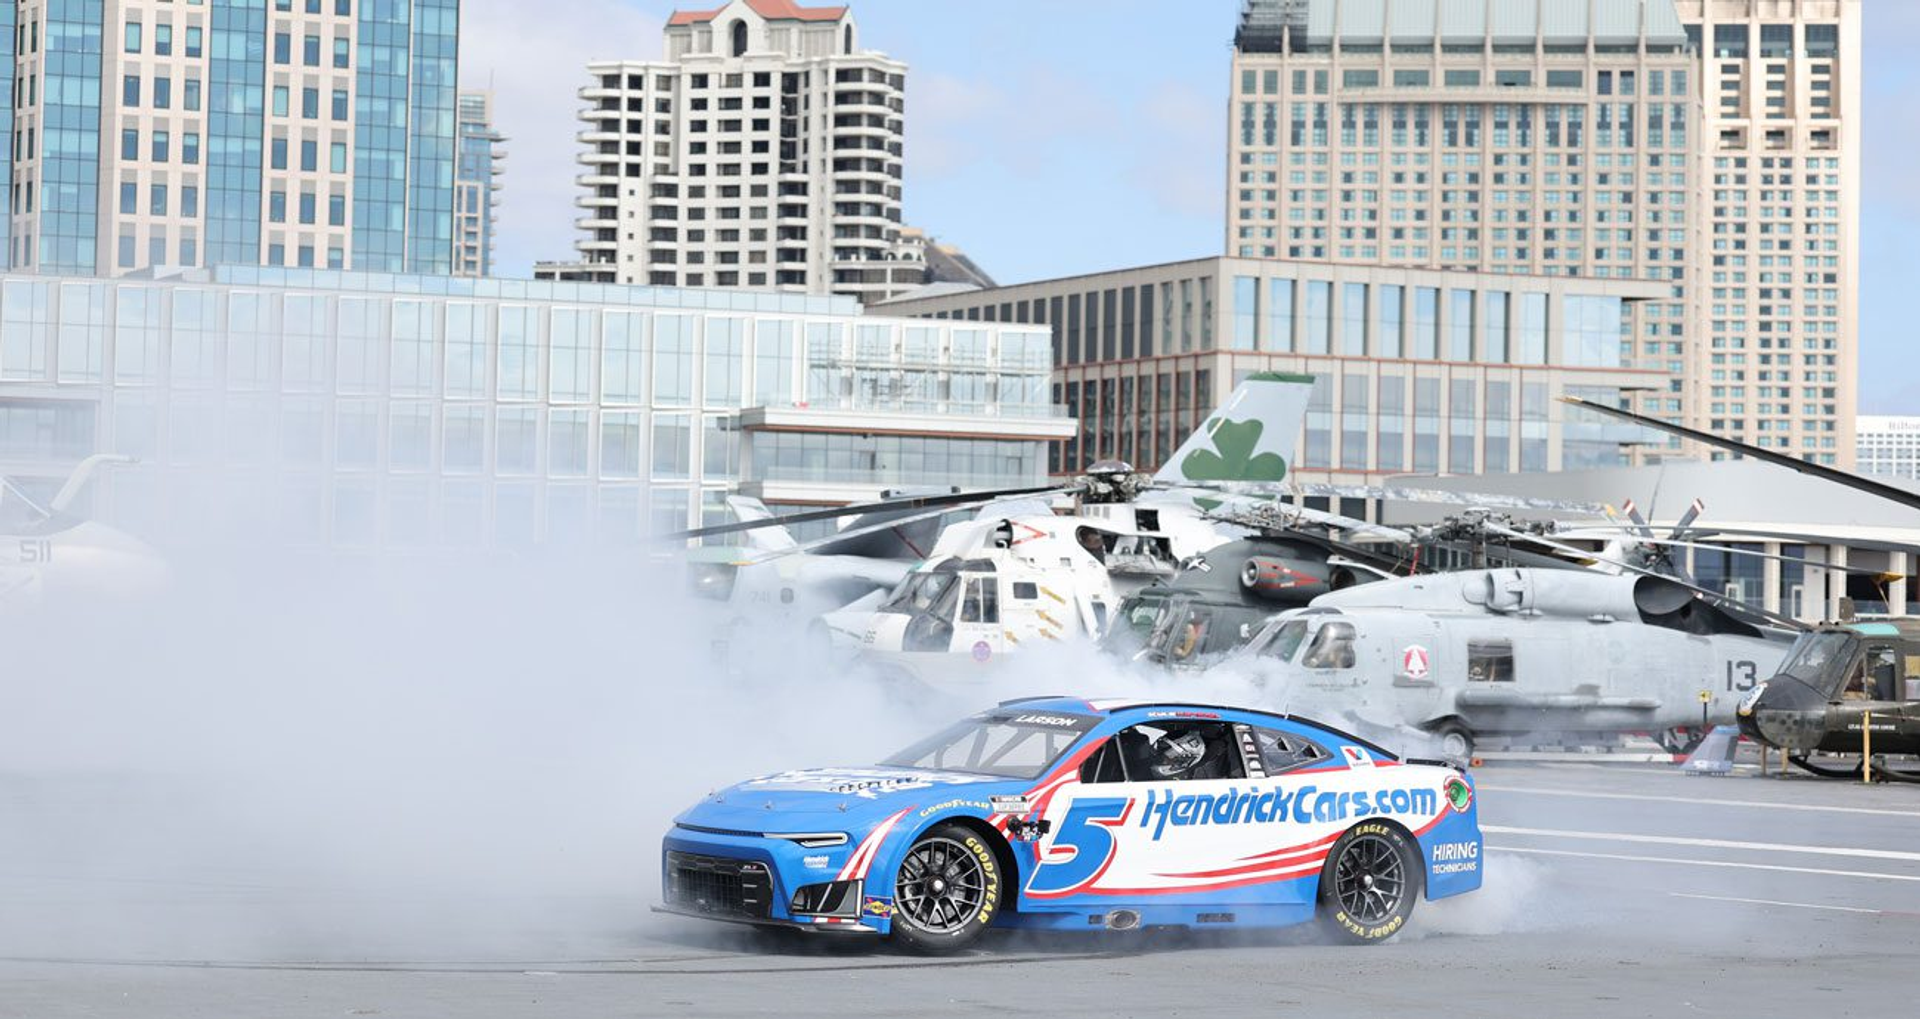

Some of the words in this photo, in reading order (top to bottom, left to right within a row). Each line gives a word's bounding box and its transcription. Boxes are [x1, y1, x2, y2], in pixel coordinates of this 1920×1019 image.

[20, 539, 51, 562] 511
[1726, 660, 1757, 692] 13
[1015, 714, 1078, 727] LARSON
[920, 798, 990, 817] GOODYEAR
[1140, 786, 1437, 842] HendrickCars.com
[1355, 824, 1390, 836] EAGLE
[1025, 796, 1136, 898] 5
[1433, 842, 1478, 861] HIRING
[1432, 862, 1477, 874] TECHNICIANS
[965, 837, 997, 923] GOODYEAR
[1336, 911, 1402, 938] GOODYEAR
